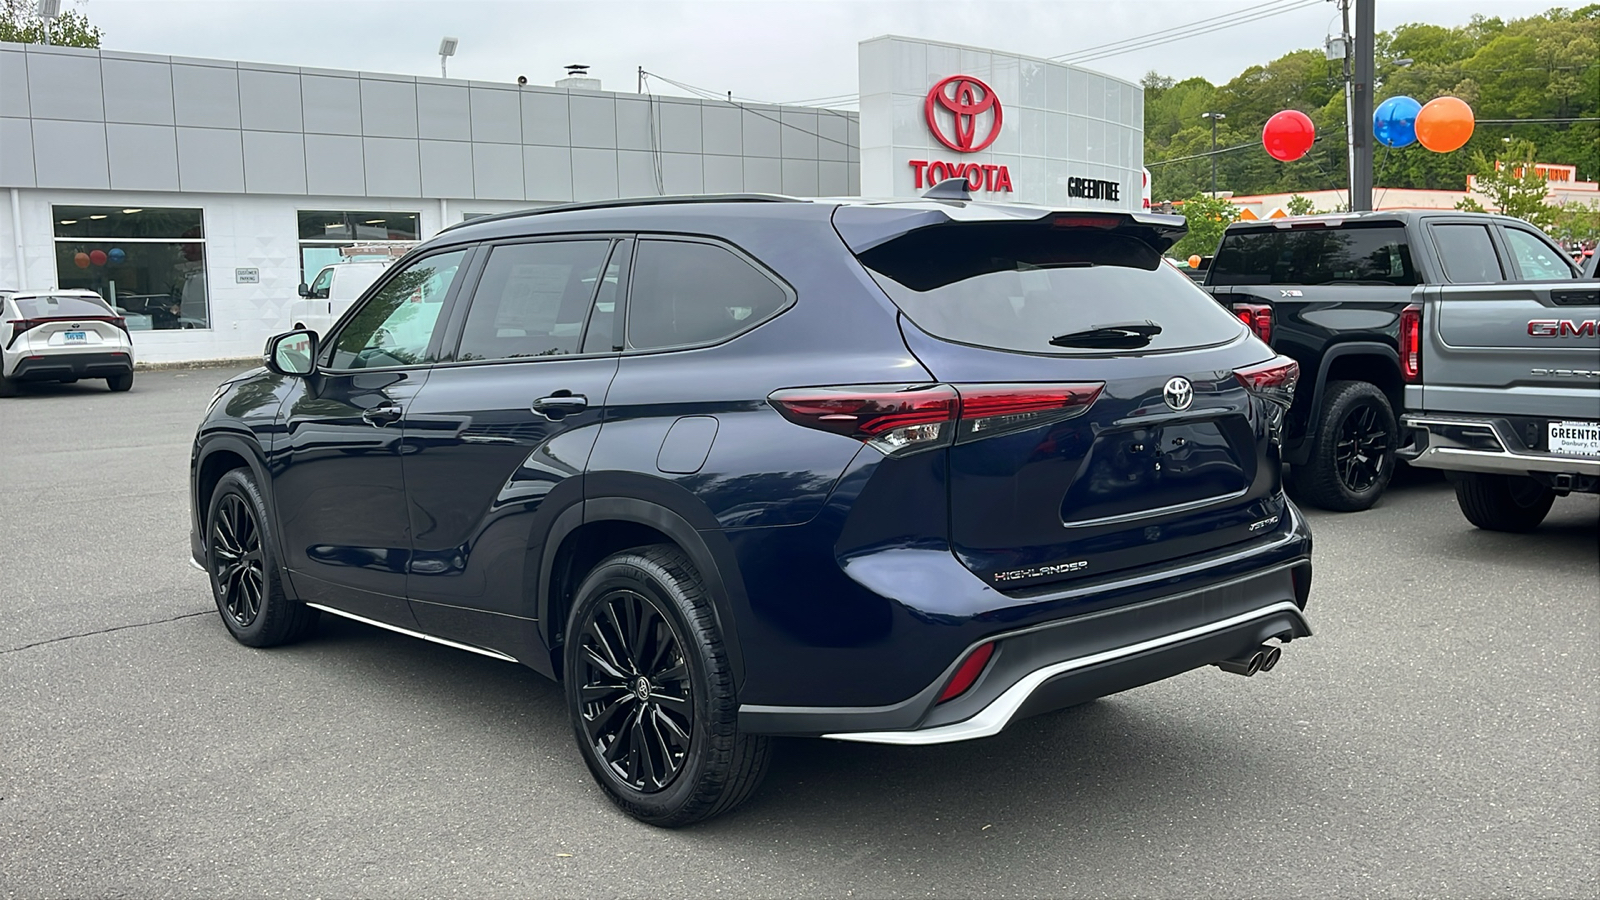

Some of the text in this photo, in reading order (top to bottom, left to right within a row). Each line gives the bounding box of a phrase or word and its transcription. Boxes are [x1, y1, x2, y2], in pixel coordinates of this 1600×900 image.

[909, 160, 1013, 192] TOYOTA
[1527, 319, 1600, 337] GM
[1551, 427, 1600, 440] GREENTR
[994, 560, 1088, 582] HIGHLANDER
